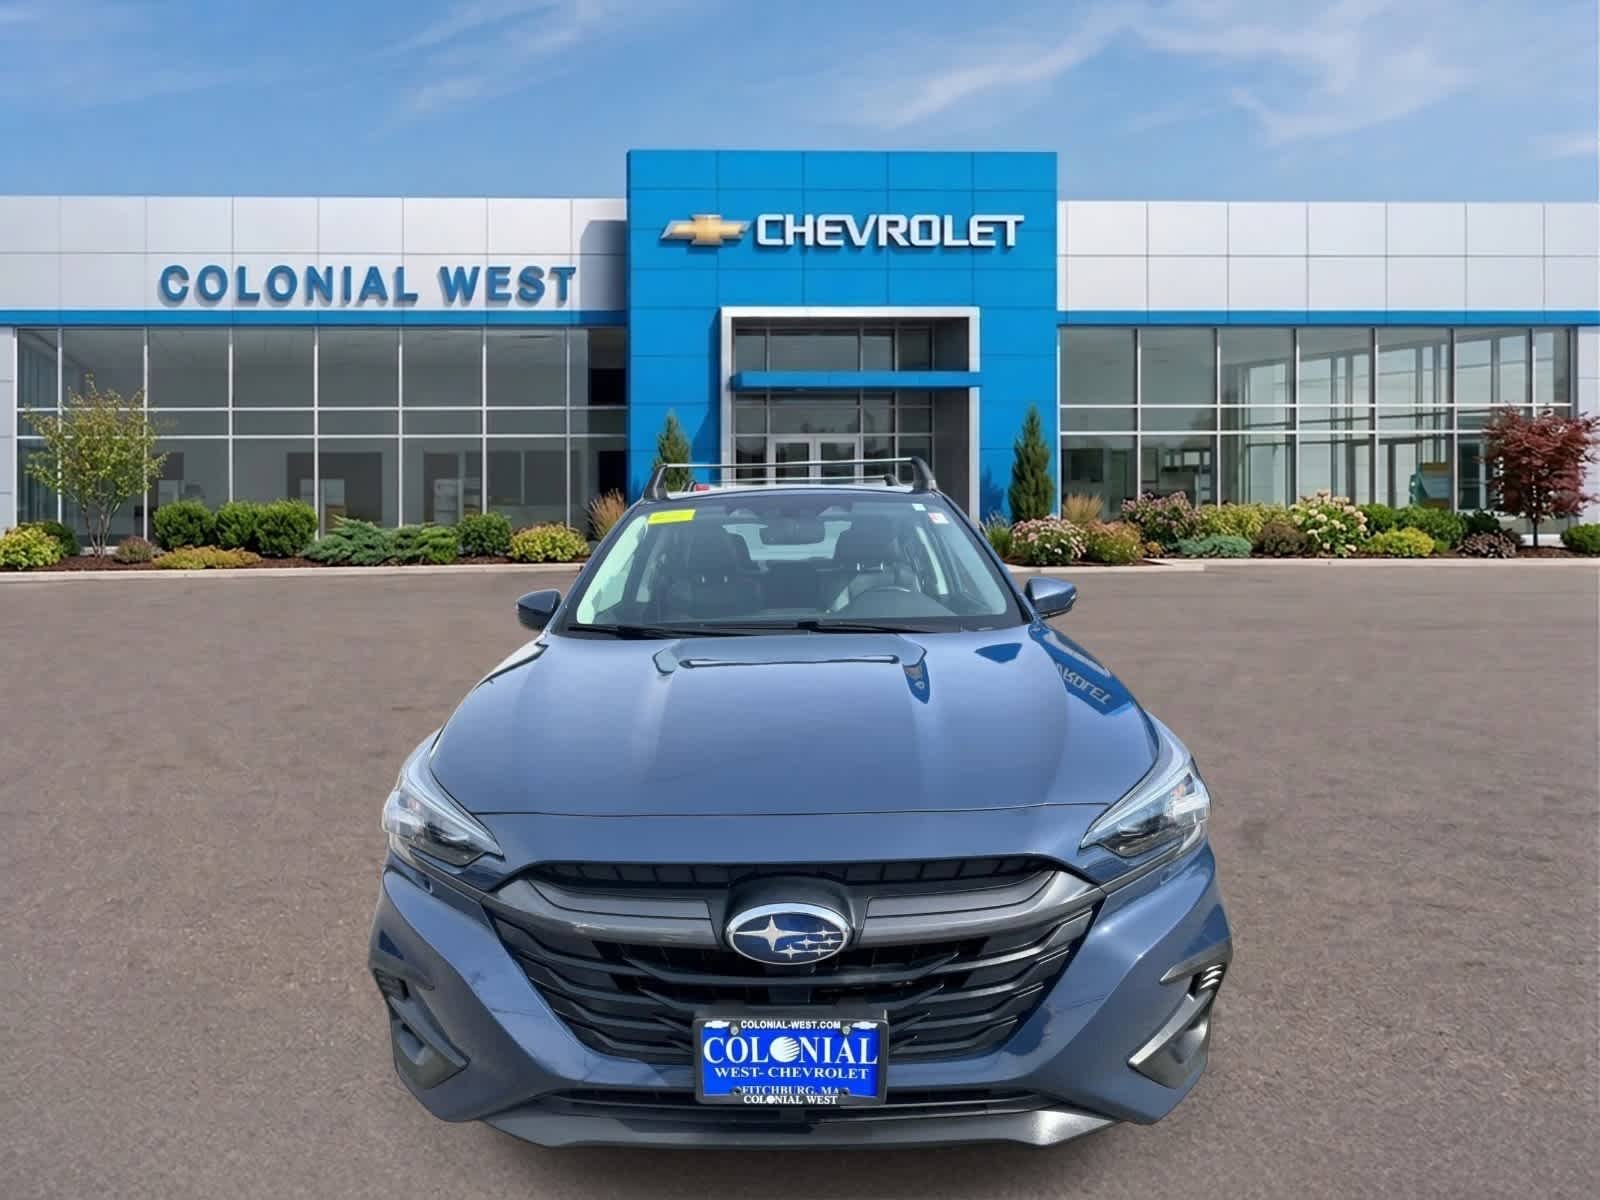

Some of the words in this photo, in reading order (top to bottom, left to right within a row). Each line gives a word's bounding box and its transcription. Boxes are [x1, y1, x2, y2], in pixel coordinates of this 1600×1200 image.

[756, 214, 1024, 247] CHEVROLET
[160, 265, 418, 302] COLONIAL
[438, 266, 577, 302] WEST
[740, 1020, 841, 1030] COLONIAL-WEST.COM
[703, 1036, 878, 1065] COLONIAL
[767, 1066, 870, 1080] CHEVROLET
[743, 1095, 804, 1105] COLONIAL
[806, 1095, 838, 1105] WEST
